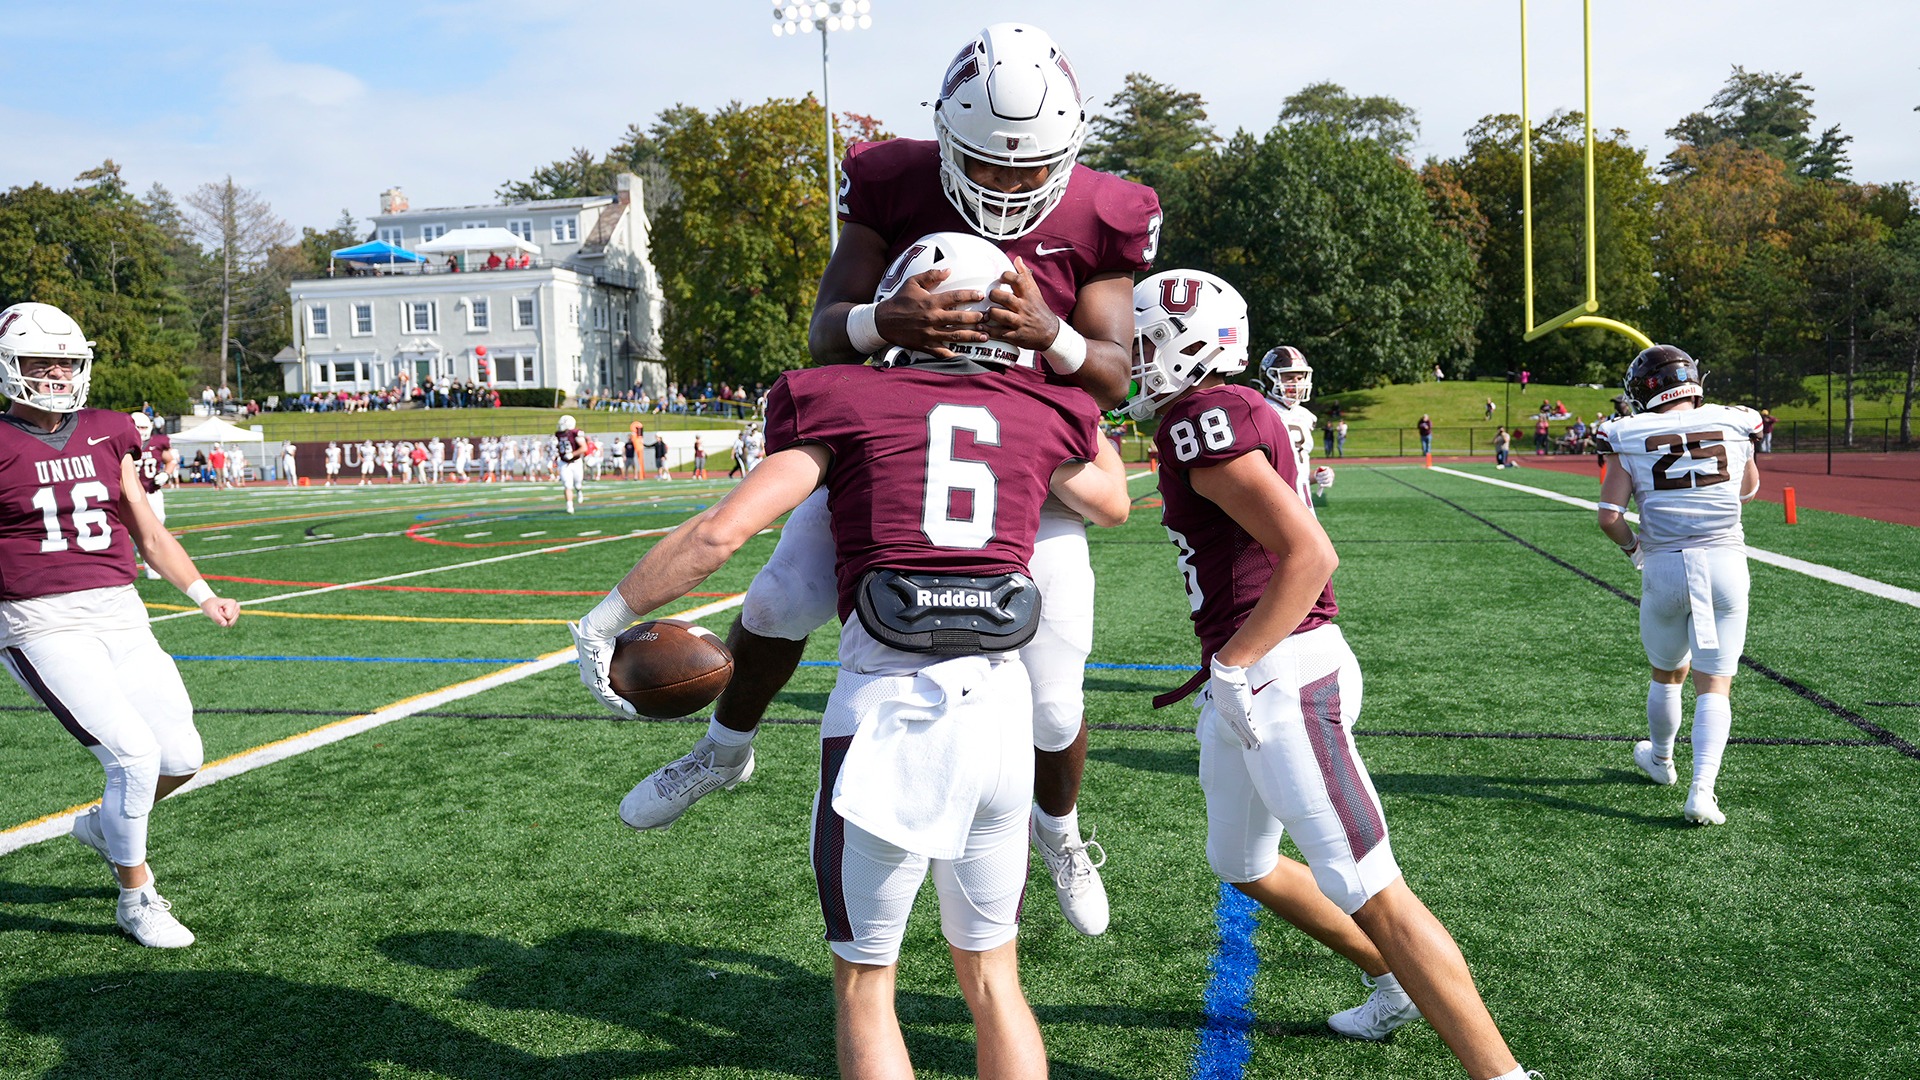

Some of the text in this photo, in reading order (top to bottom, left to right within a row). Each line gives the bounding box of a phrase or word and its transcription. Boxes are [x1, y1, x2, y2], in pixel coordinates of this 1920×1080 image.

[1005, 136, 1020, 151] U
[1158, 277, 1204, 316] U
[1168, 406, 1237, 465] 88
[1644, 430, 1731, 491] 25
[35, 454, 97, 484] UNION
[920, 402, 1001, 550] 6
[31, 480, 113, 554] 16
